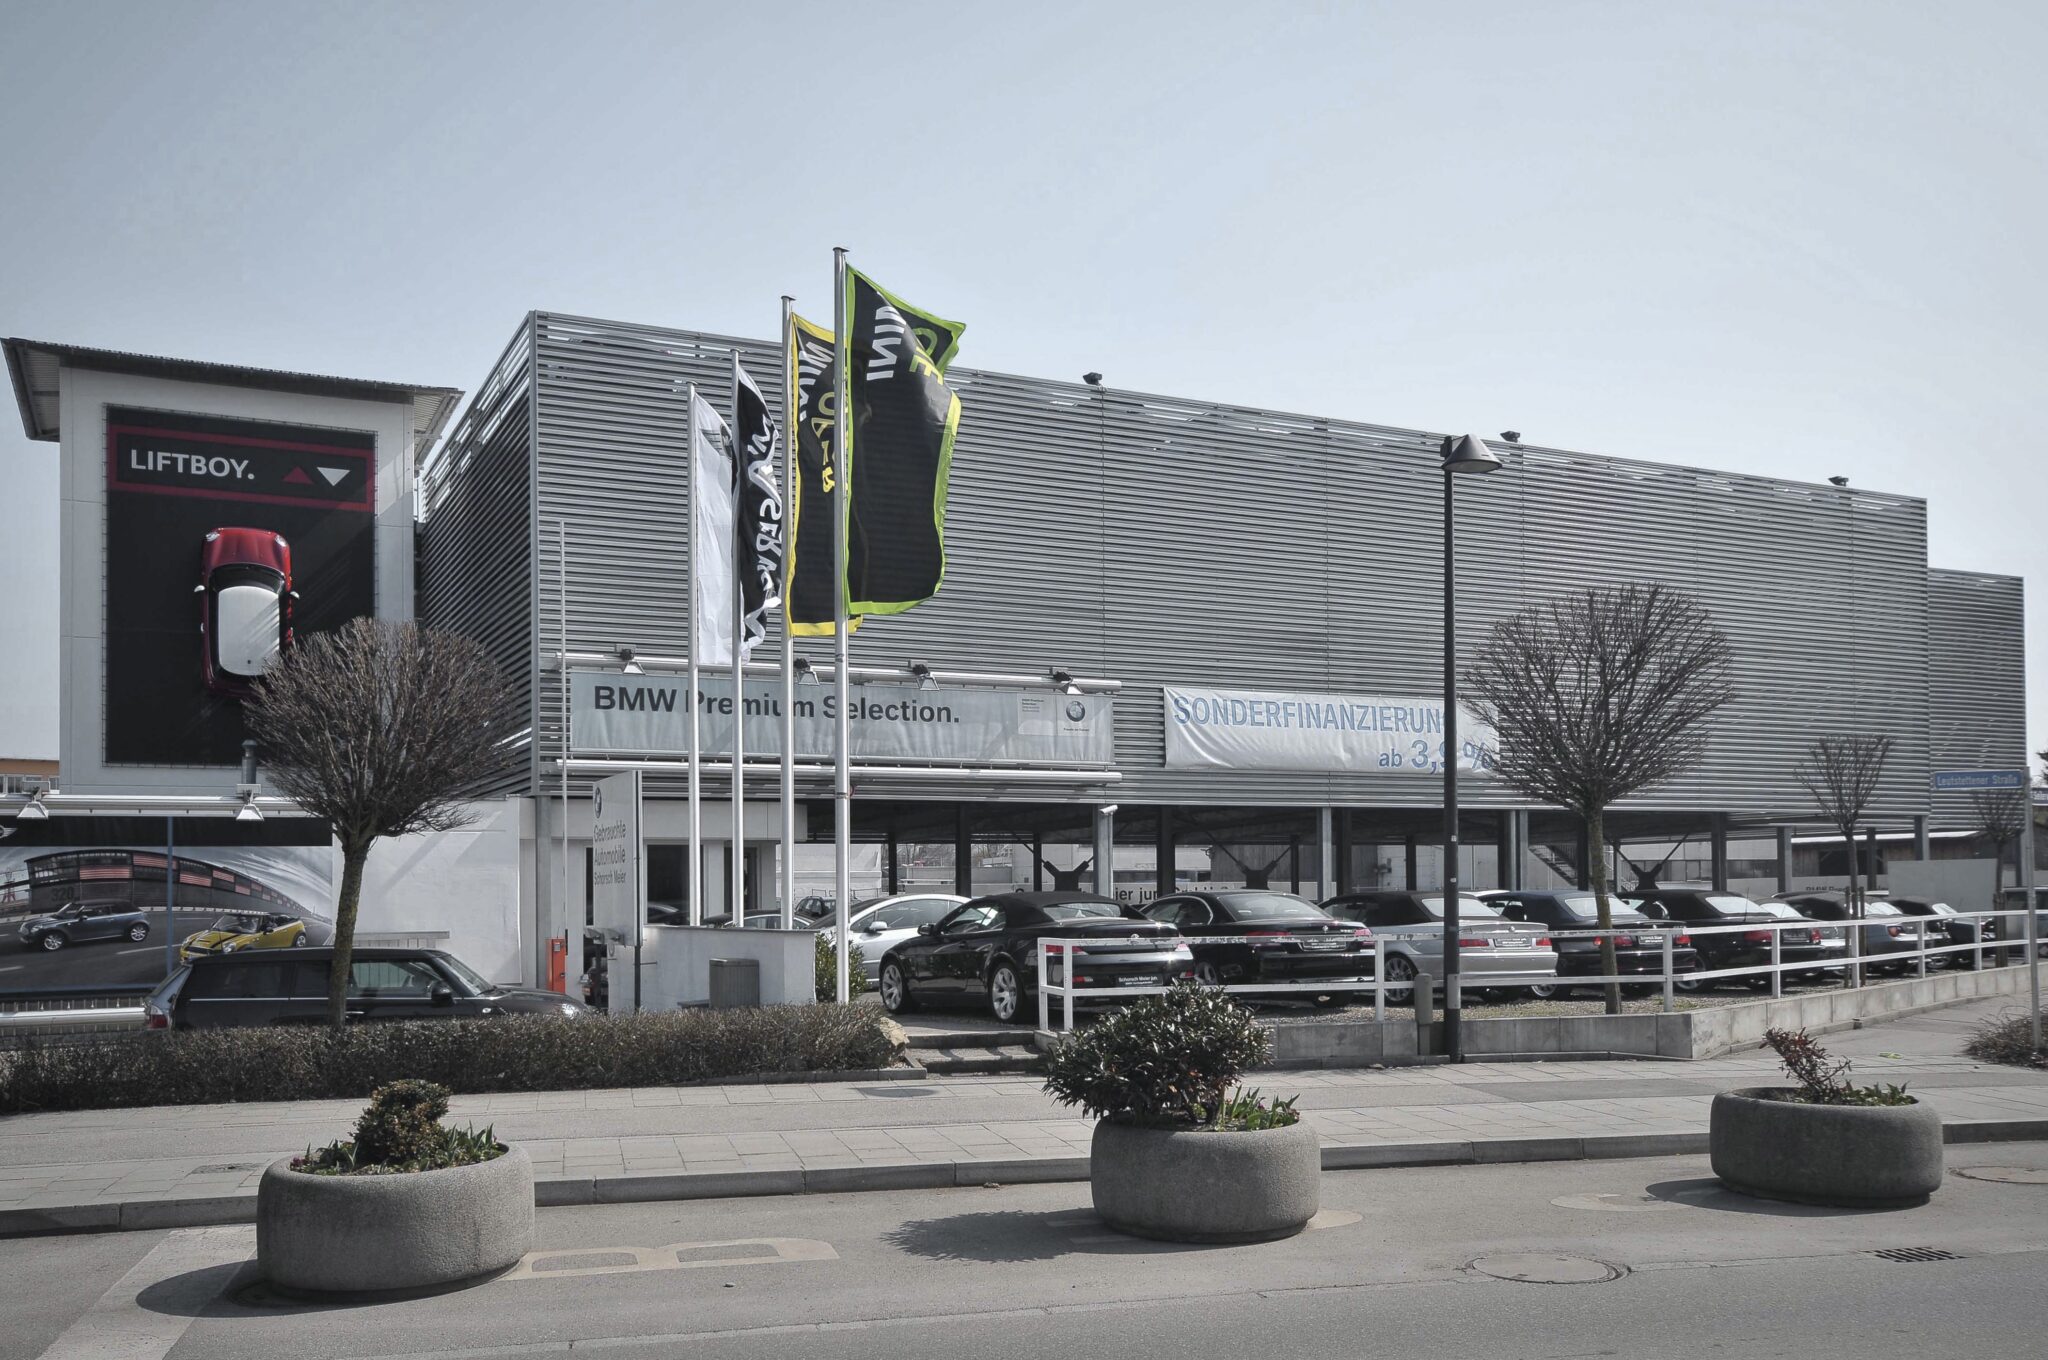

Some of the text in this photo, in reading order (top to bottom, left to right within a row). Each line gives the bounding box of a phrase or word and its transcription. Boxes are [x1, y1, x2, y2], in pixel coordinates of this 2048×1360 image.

[130, 448, 255, 480] LIFTBOY.
[594, 685, 677, 712] BMW
[822, 695, 960, 723] Selection.
[1173, 695, 1445, 734] SONDERFINANZIERUN
[1379, 748, 1403, 767] ab
